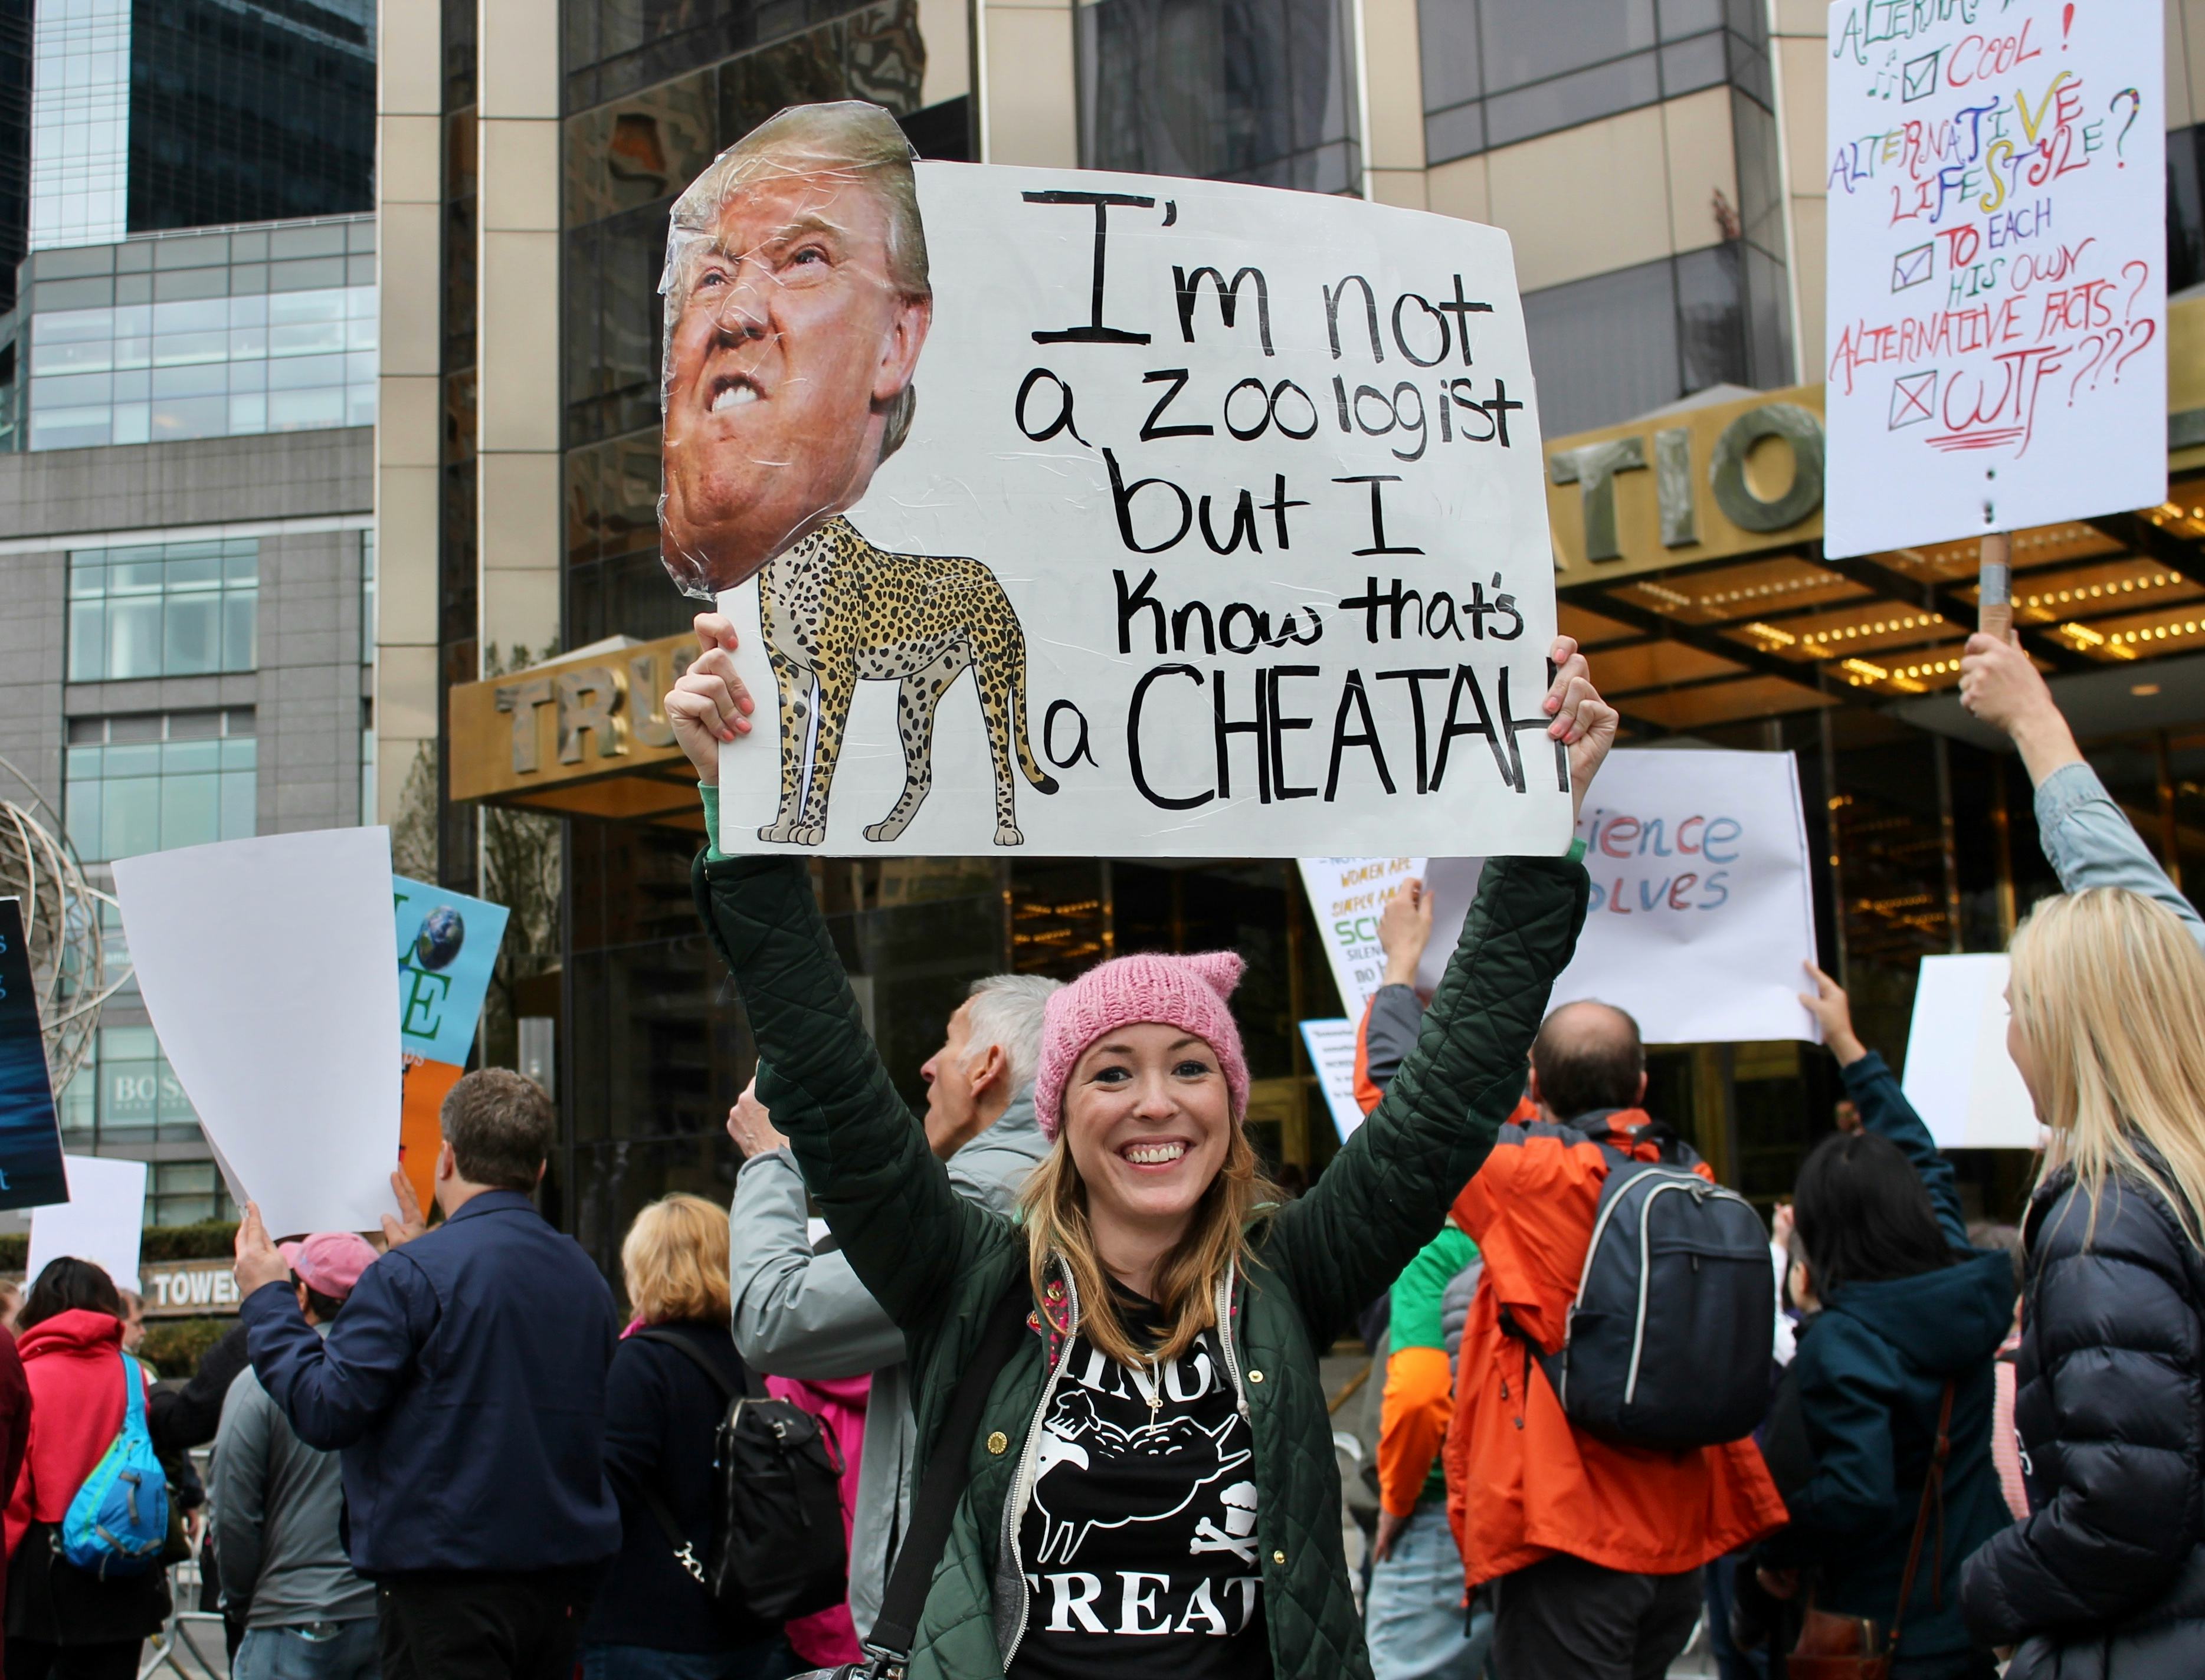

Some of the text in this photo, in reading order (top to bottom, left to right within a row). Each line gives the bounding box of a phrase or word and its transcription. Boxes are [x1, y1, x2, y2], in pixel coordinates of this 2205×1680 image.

[1827, 71, 2084, 193] ALTERNATIVE
[1022, 191, 1494, 366] I'm not
[1935, 198, 2052, 270] TO EACH
[1947, 237, 2096, 308] HIS OWN
[1829, 295, 2027, 396] ALTERNATIVE
[1015, 367, 1523, 462] a zoologist
[1102, 447, 1426, 556] but I
[1551, 402, 1824, 567] TIO
[1338, 571, 1525, 644] that's
[1044, 656, 1570, 811] a CHEATAH
[1577, 808, 1742, 864] ience
[116, 1075, 187, 1102] BOS
